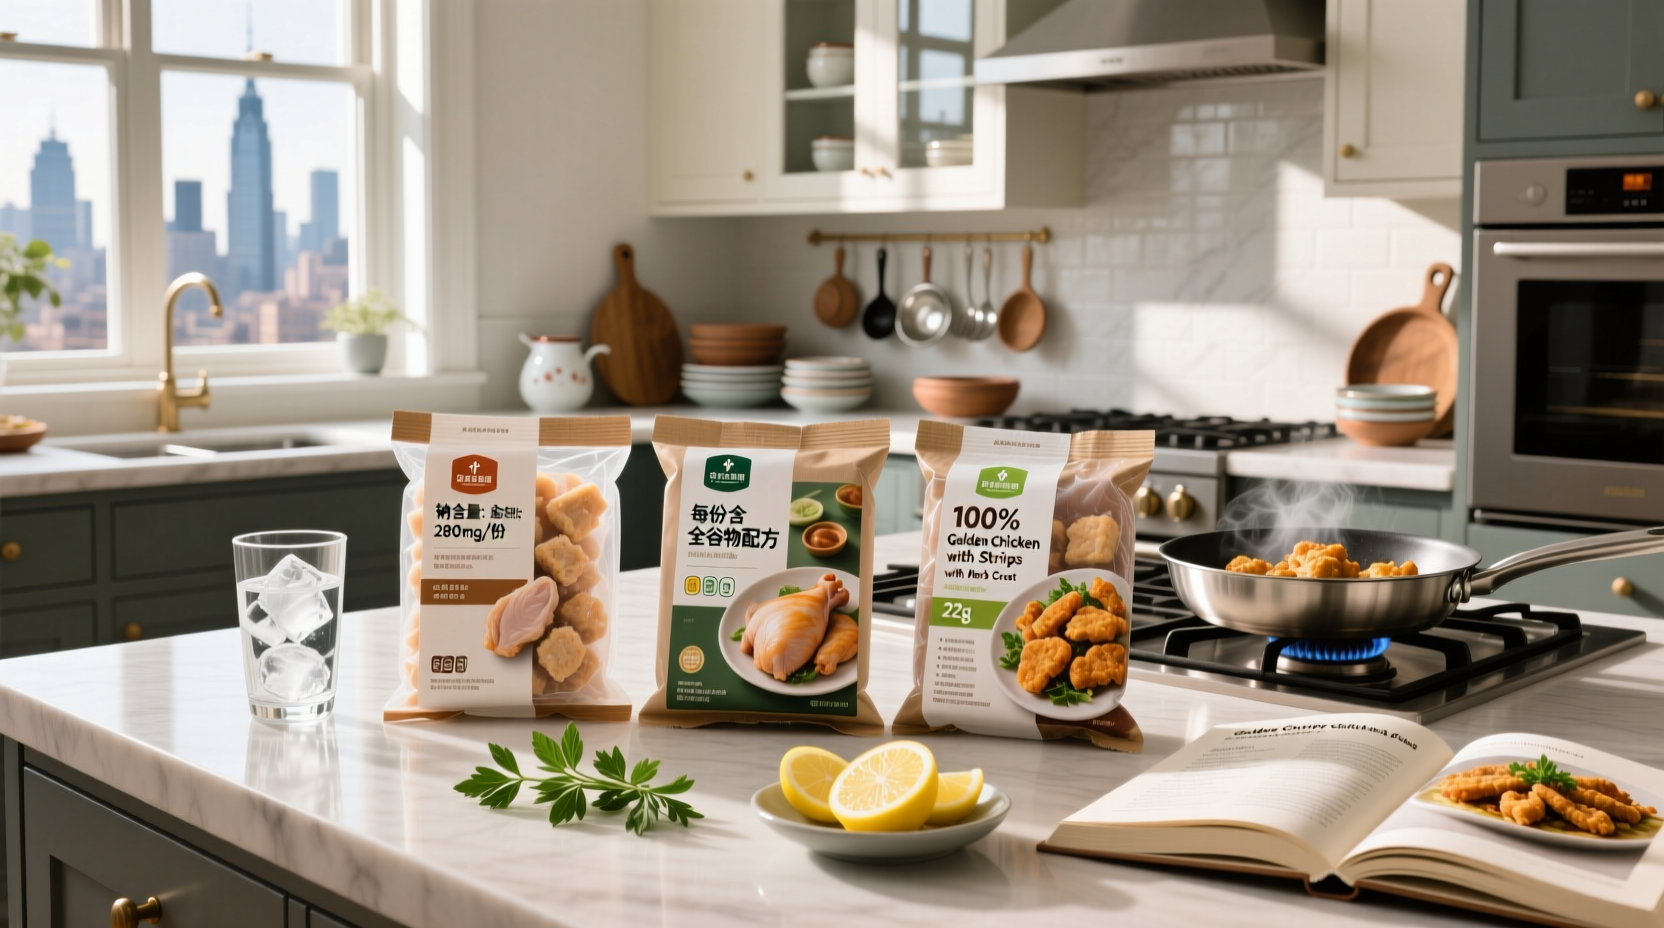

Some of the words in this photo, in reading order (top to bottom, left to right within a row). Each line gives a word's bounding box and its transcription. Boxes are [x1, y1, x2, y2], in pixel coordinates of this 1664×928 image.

[690, 503, 747, 525] 每份含
[953, 505, 1020, 531] 100%
[687, 525, 780, 550] 全谷物配方
[990, 534, 1040, 550] Chicken
[946, 549, 975, 563] with
[941, 601, 972, 624] 22g
